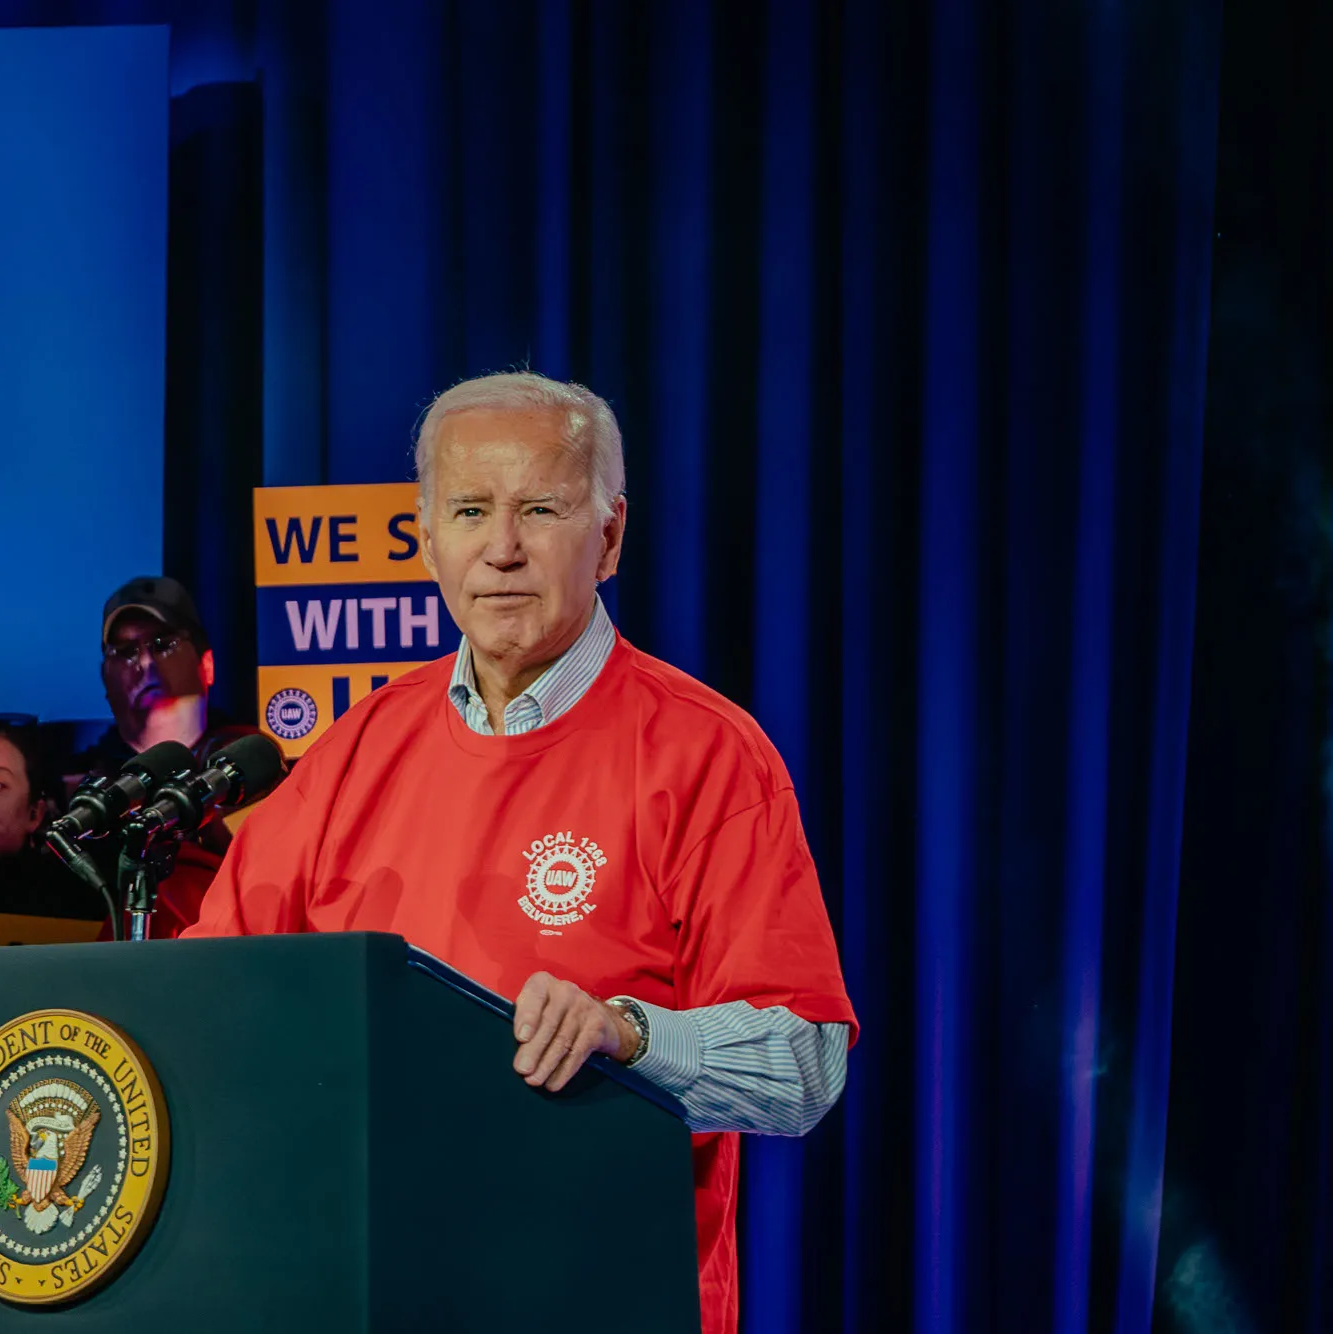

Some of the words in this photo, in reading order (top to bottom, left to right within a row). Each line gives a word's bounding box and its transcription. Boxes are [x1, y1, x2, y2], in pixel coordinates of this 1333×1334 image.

[264, 515, 359, 565] WE
[284, 595, 440, 652] WITH
[522, 831, 575, 861] LOCAL
[580, 837, 608, 868] 1268
[546, 869, 579, 887] UAW
[517, 895, 584, 926] BELVIDERE,
[581, 903, 597, 915] IL
[59, 1023, 81, 1042] OF
[84, 1030, 112, 1060] THE
[113, 1057, 151, 1178] UNITED
[50, 1204, 134, 1290] STATES
